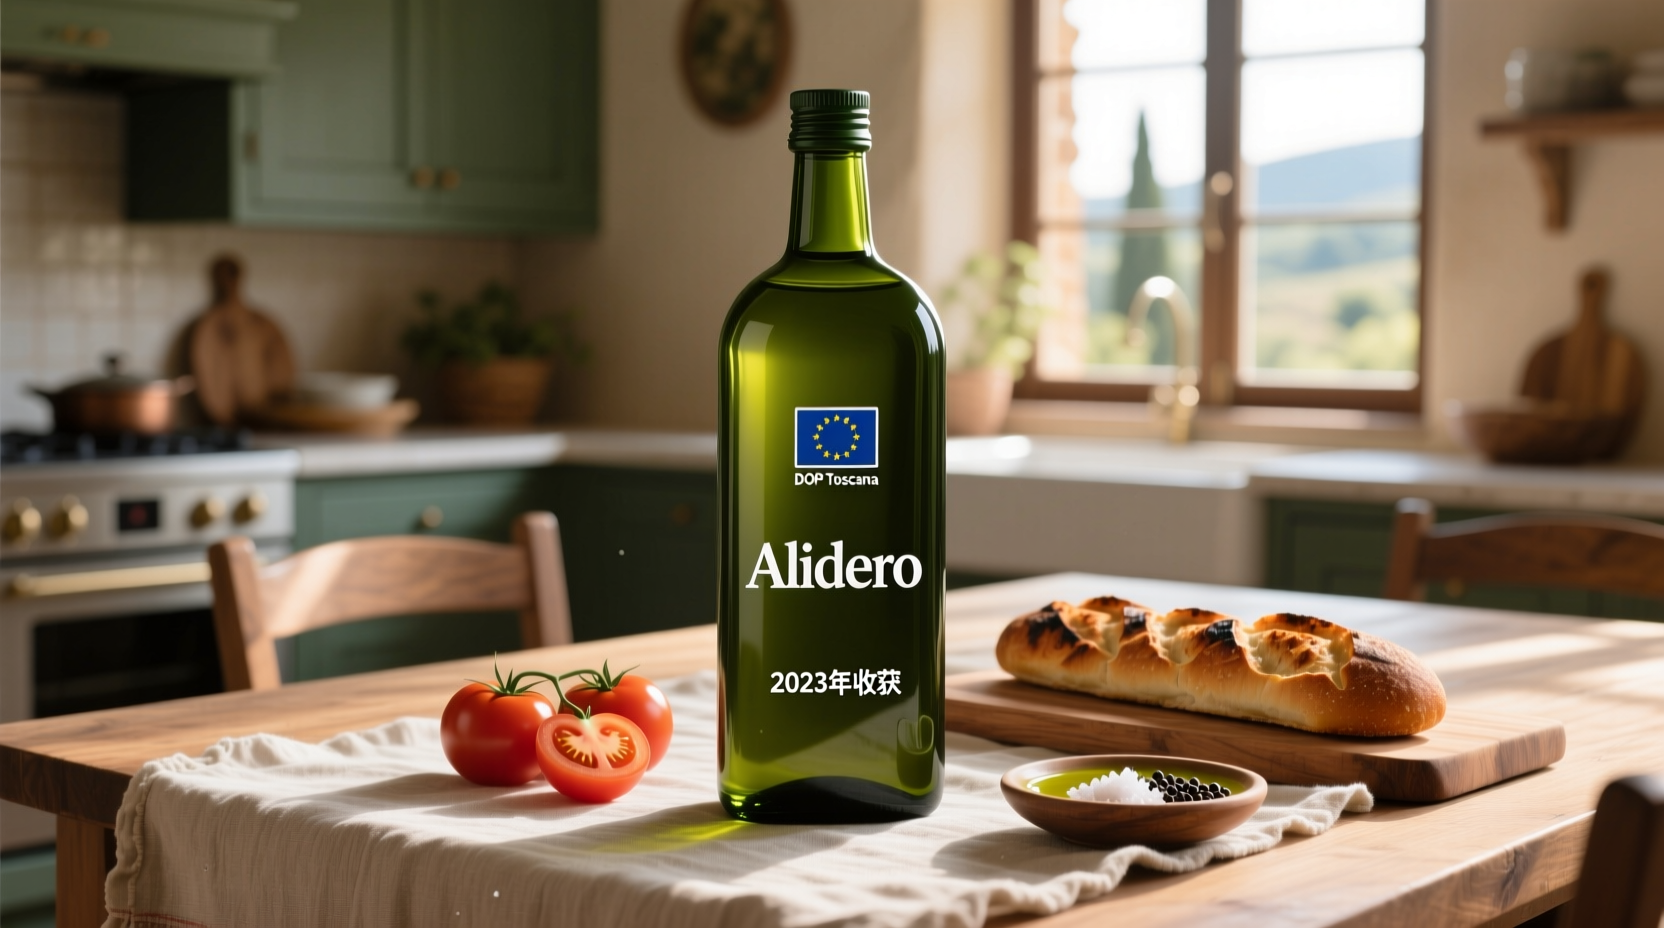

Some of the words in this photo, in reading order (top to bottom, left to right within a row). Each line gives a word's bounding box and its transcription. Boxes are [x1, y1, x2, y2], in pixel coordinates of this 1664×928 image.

[794, 472, 824, 486] DOP
[825, 472, 879, 486] Toscana
[745, 540, 923, 589] Alidero
[770, 668, 902, 697] 2023年收获
